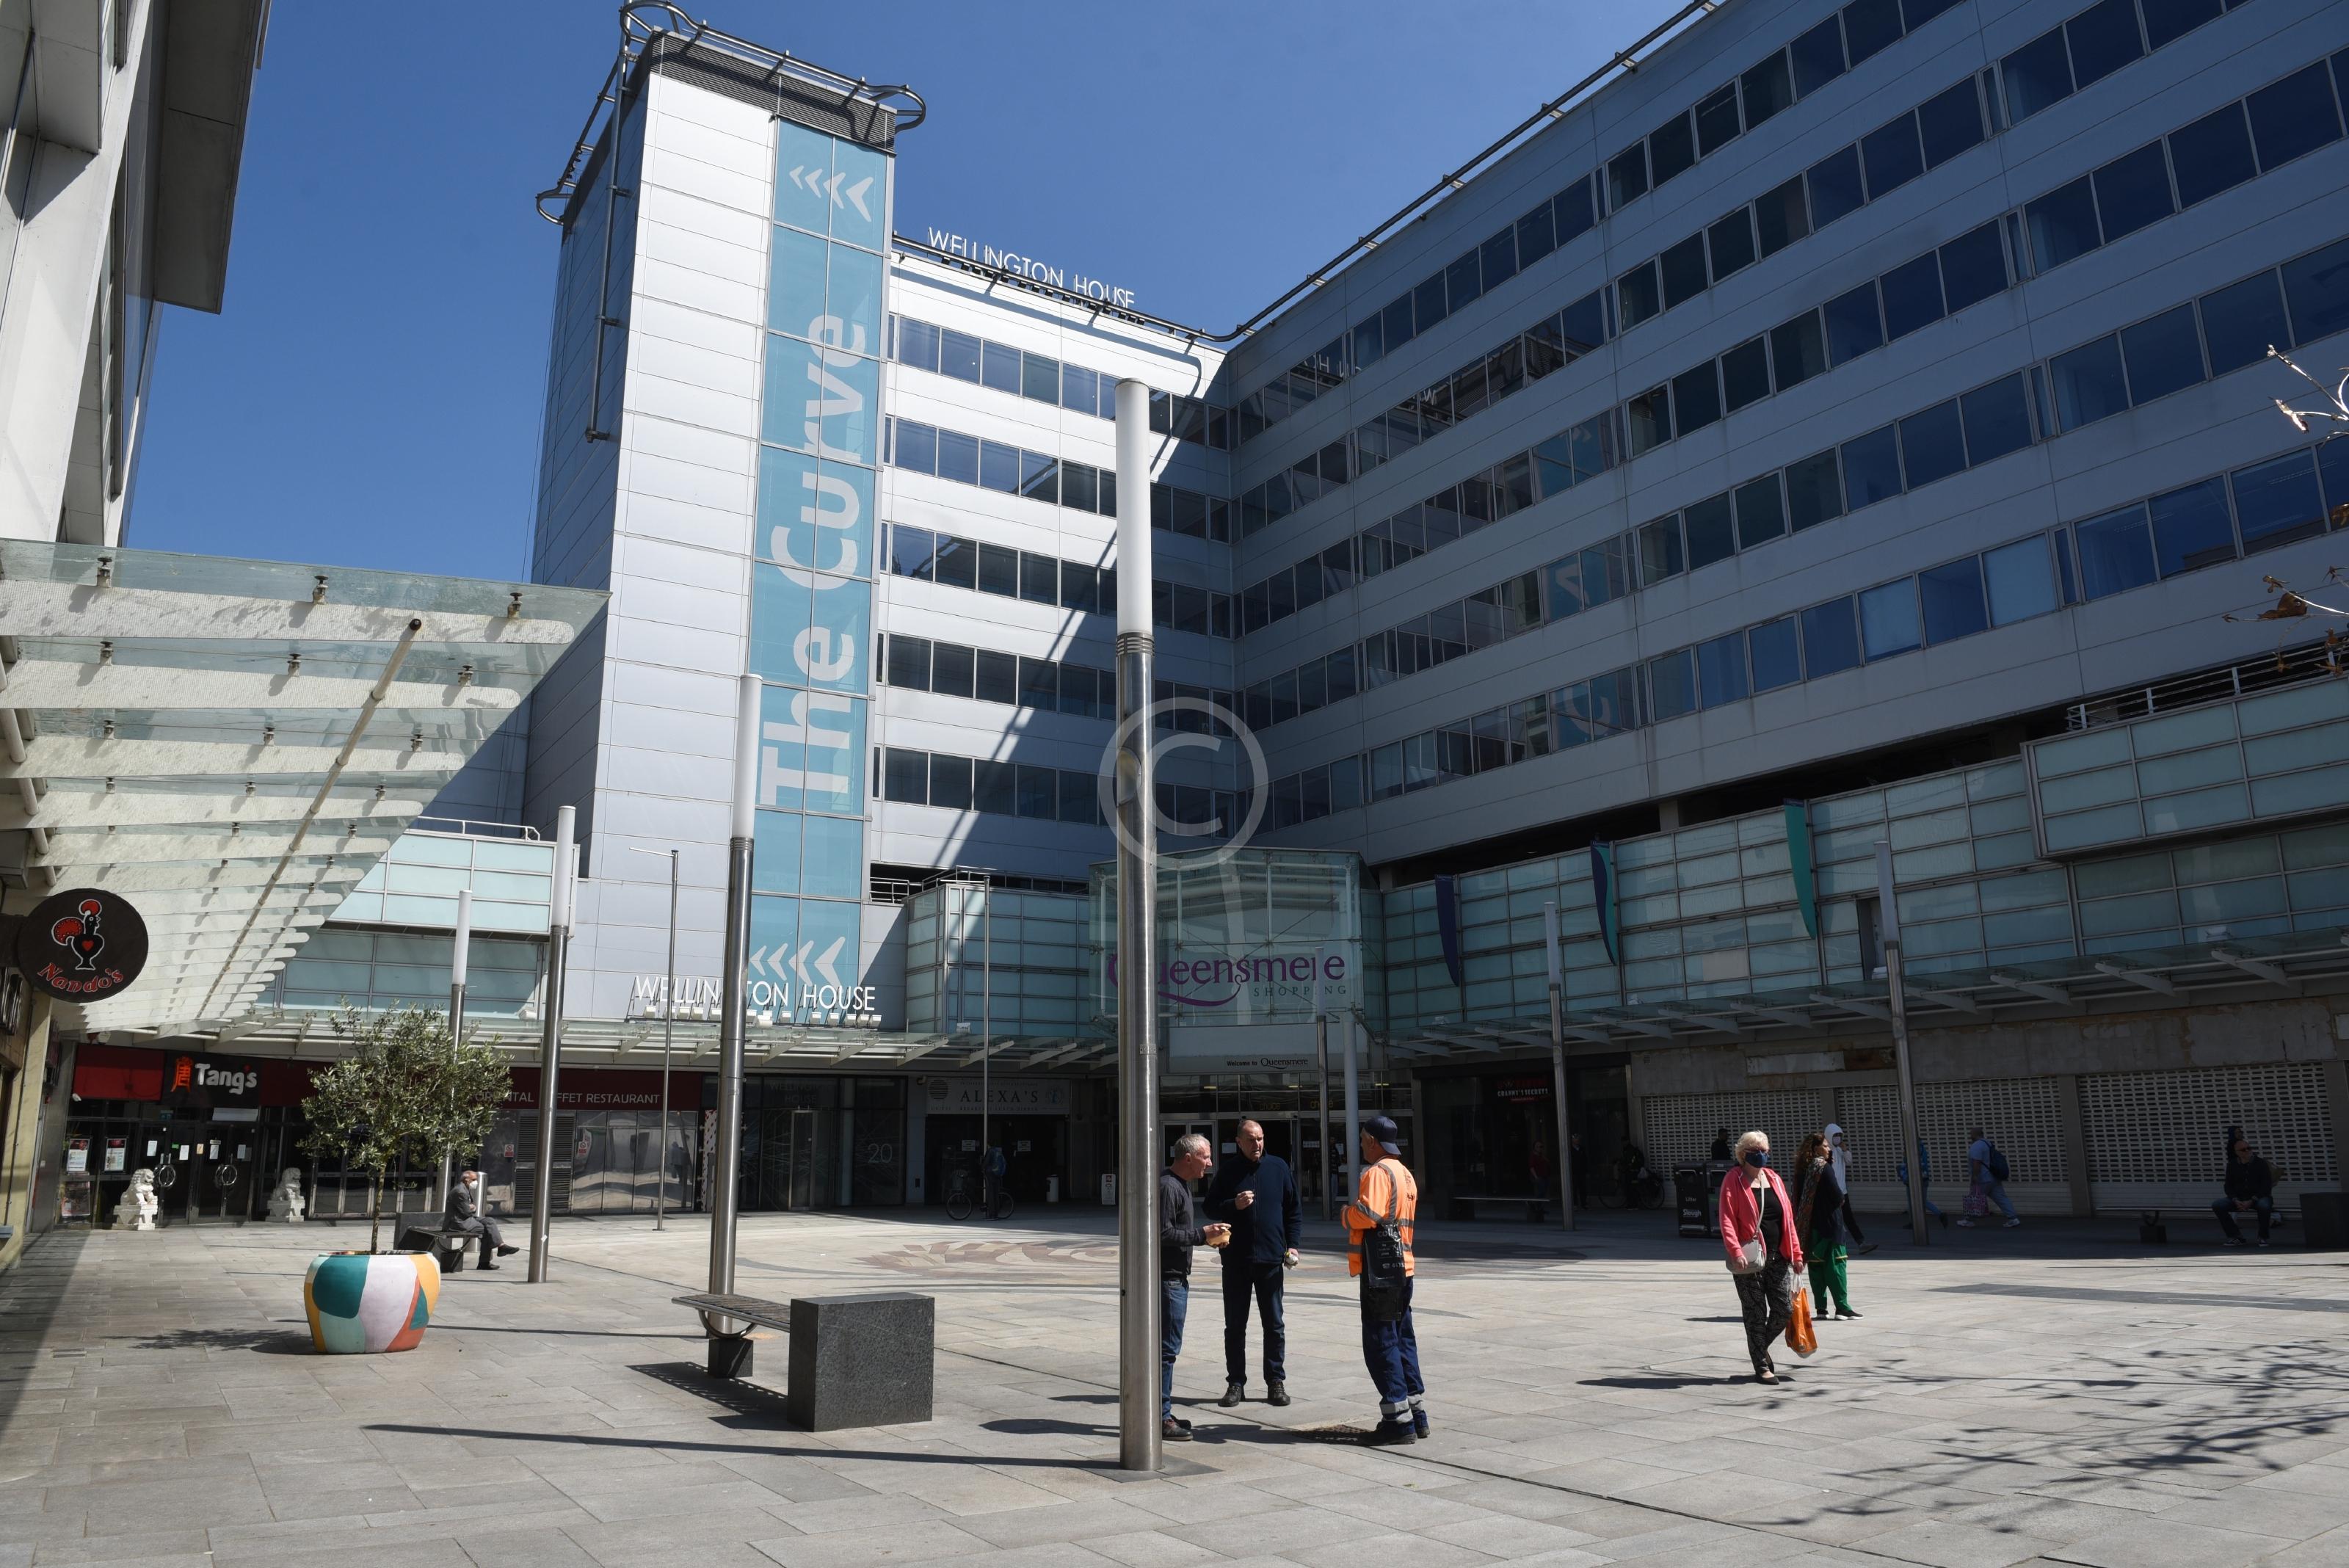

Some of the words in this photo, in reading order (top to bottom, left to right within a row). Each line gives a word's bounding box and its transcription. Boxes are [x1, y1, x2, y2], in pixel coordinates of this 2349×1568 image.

[929, 227, 1063, 288] WELLINGTON
[1074, 275, 1135, 308] HOUSE
[771, 313, 868, 589] Curve
[759, 625, 857, 805] The
[37, 962, 124, 992] Nando's
[1108, 954, 1345, 1007] eensmee
[635, 976, 788, 1006] WELLINON
[804, 984, 876, 1011] HOUSE
[1254, 985, 1347, 997] SHOPPNG
[1260, 1058, 1308, 1070] Queensmere
[475, 1092, 534, 1103] ORNTAL
[557, 1093, 582, 1103] FFET
[587, 1093, 660, 1103] RESTAURANT
[960, 1090, 1039, 1103] ALEXA'S
[867, 1143, 893, 1164] 20
[1682, 1208, 1702, 1218] Slough
